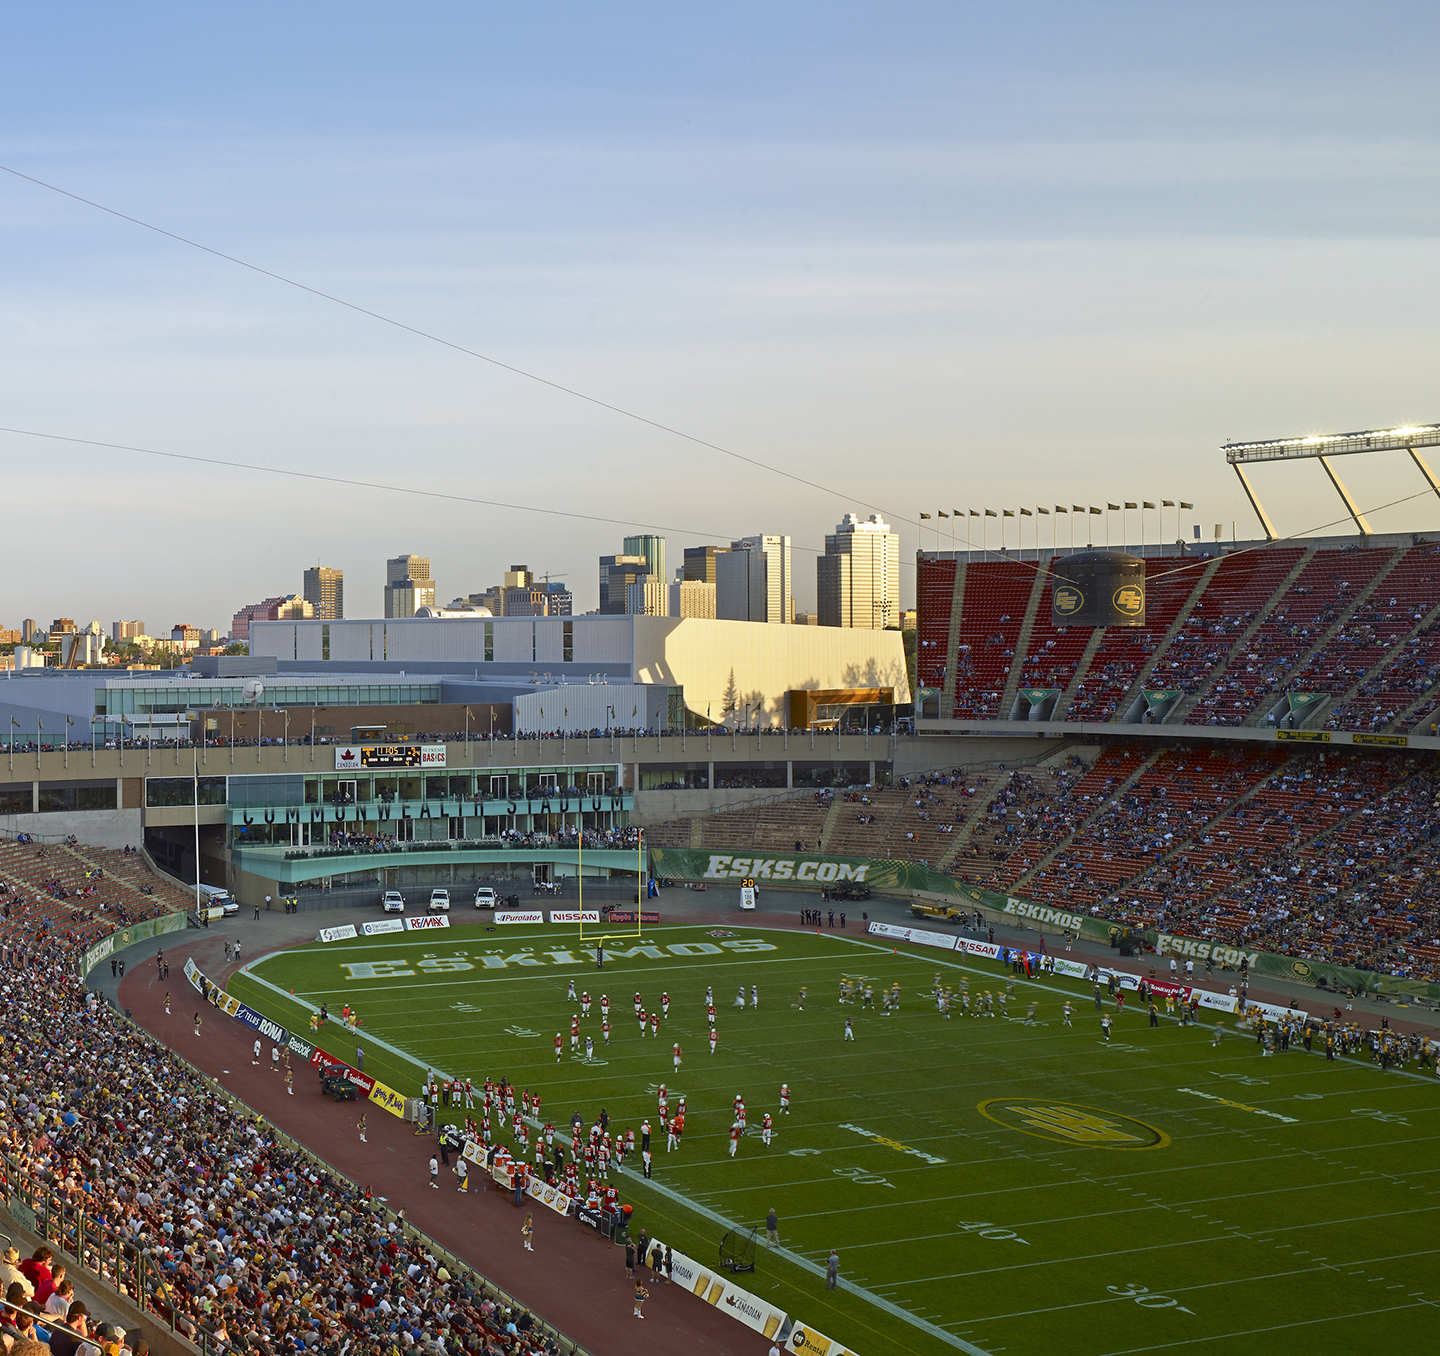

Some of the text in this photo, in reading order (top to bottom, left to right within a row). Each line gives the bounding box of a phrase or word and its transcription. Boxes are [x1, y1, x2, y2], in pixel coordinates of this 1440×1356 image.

[507, 797, 624, 815] STADIUM
[703, 855, 871, 882] ESKS.COM
[742, 878, 754, 888] 20
[410, 916, 444, 929] RE/MAX
[505, 914, 541, 922] Purolator
[553, 913, 597, 921] NISSAN
[1003, 898, 1083, 930] ESKIMOS
[423, 940, 656, 959] EDMONTON
[340, 939, 779, 980] ESKIMOS
[1064, 963, 1083, 974] foods
[244, 1011, 260, 1026] TELUS
[258, 1018, 284, 1043] RONA
[288, 1036, 311, 1058] Reebok
[347, 1073, 372, 1091] Scotiabank
[832, 1166, 887, 1185] 50
[957, 1221, 1018, 1240] 40
[1106, 1283, 1178, 1308] 30
[734, 1298, 763, 1322] CANADIAN
[804, 1340, 826, 1356] Rental
